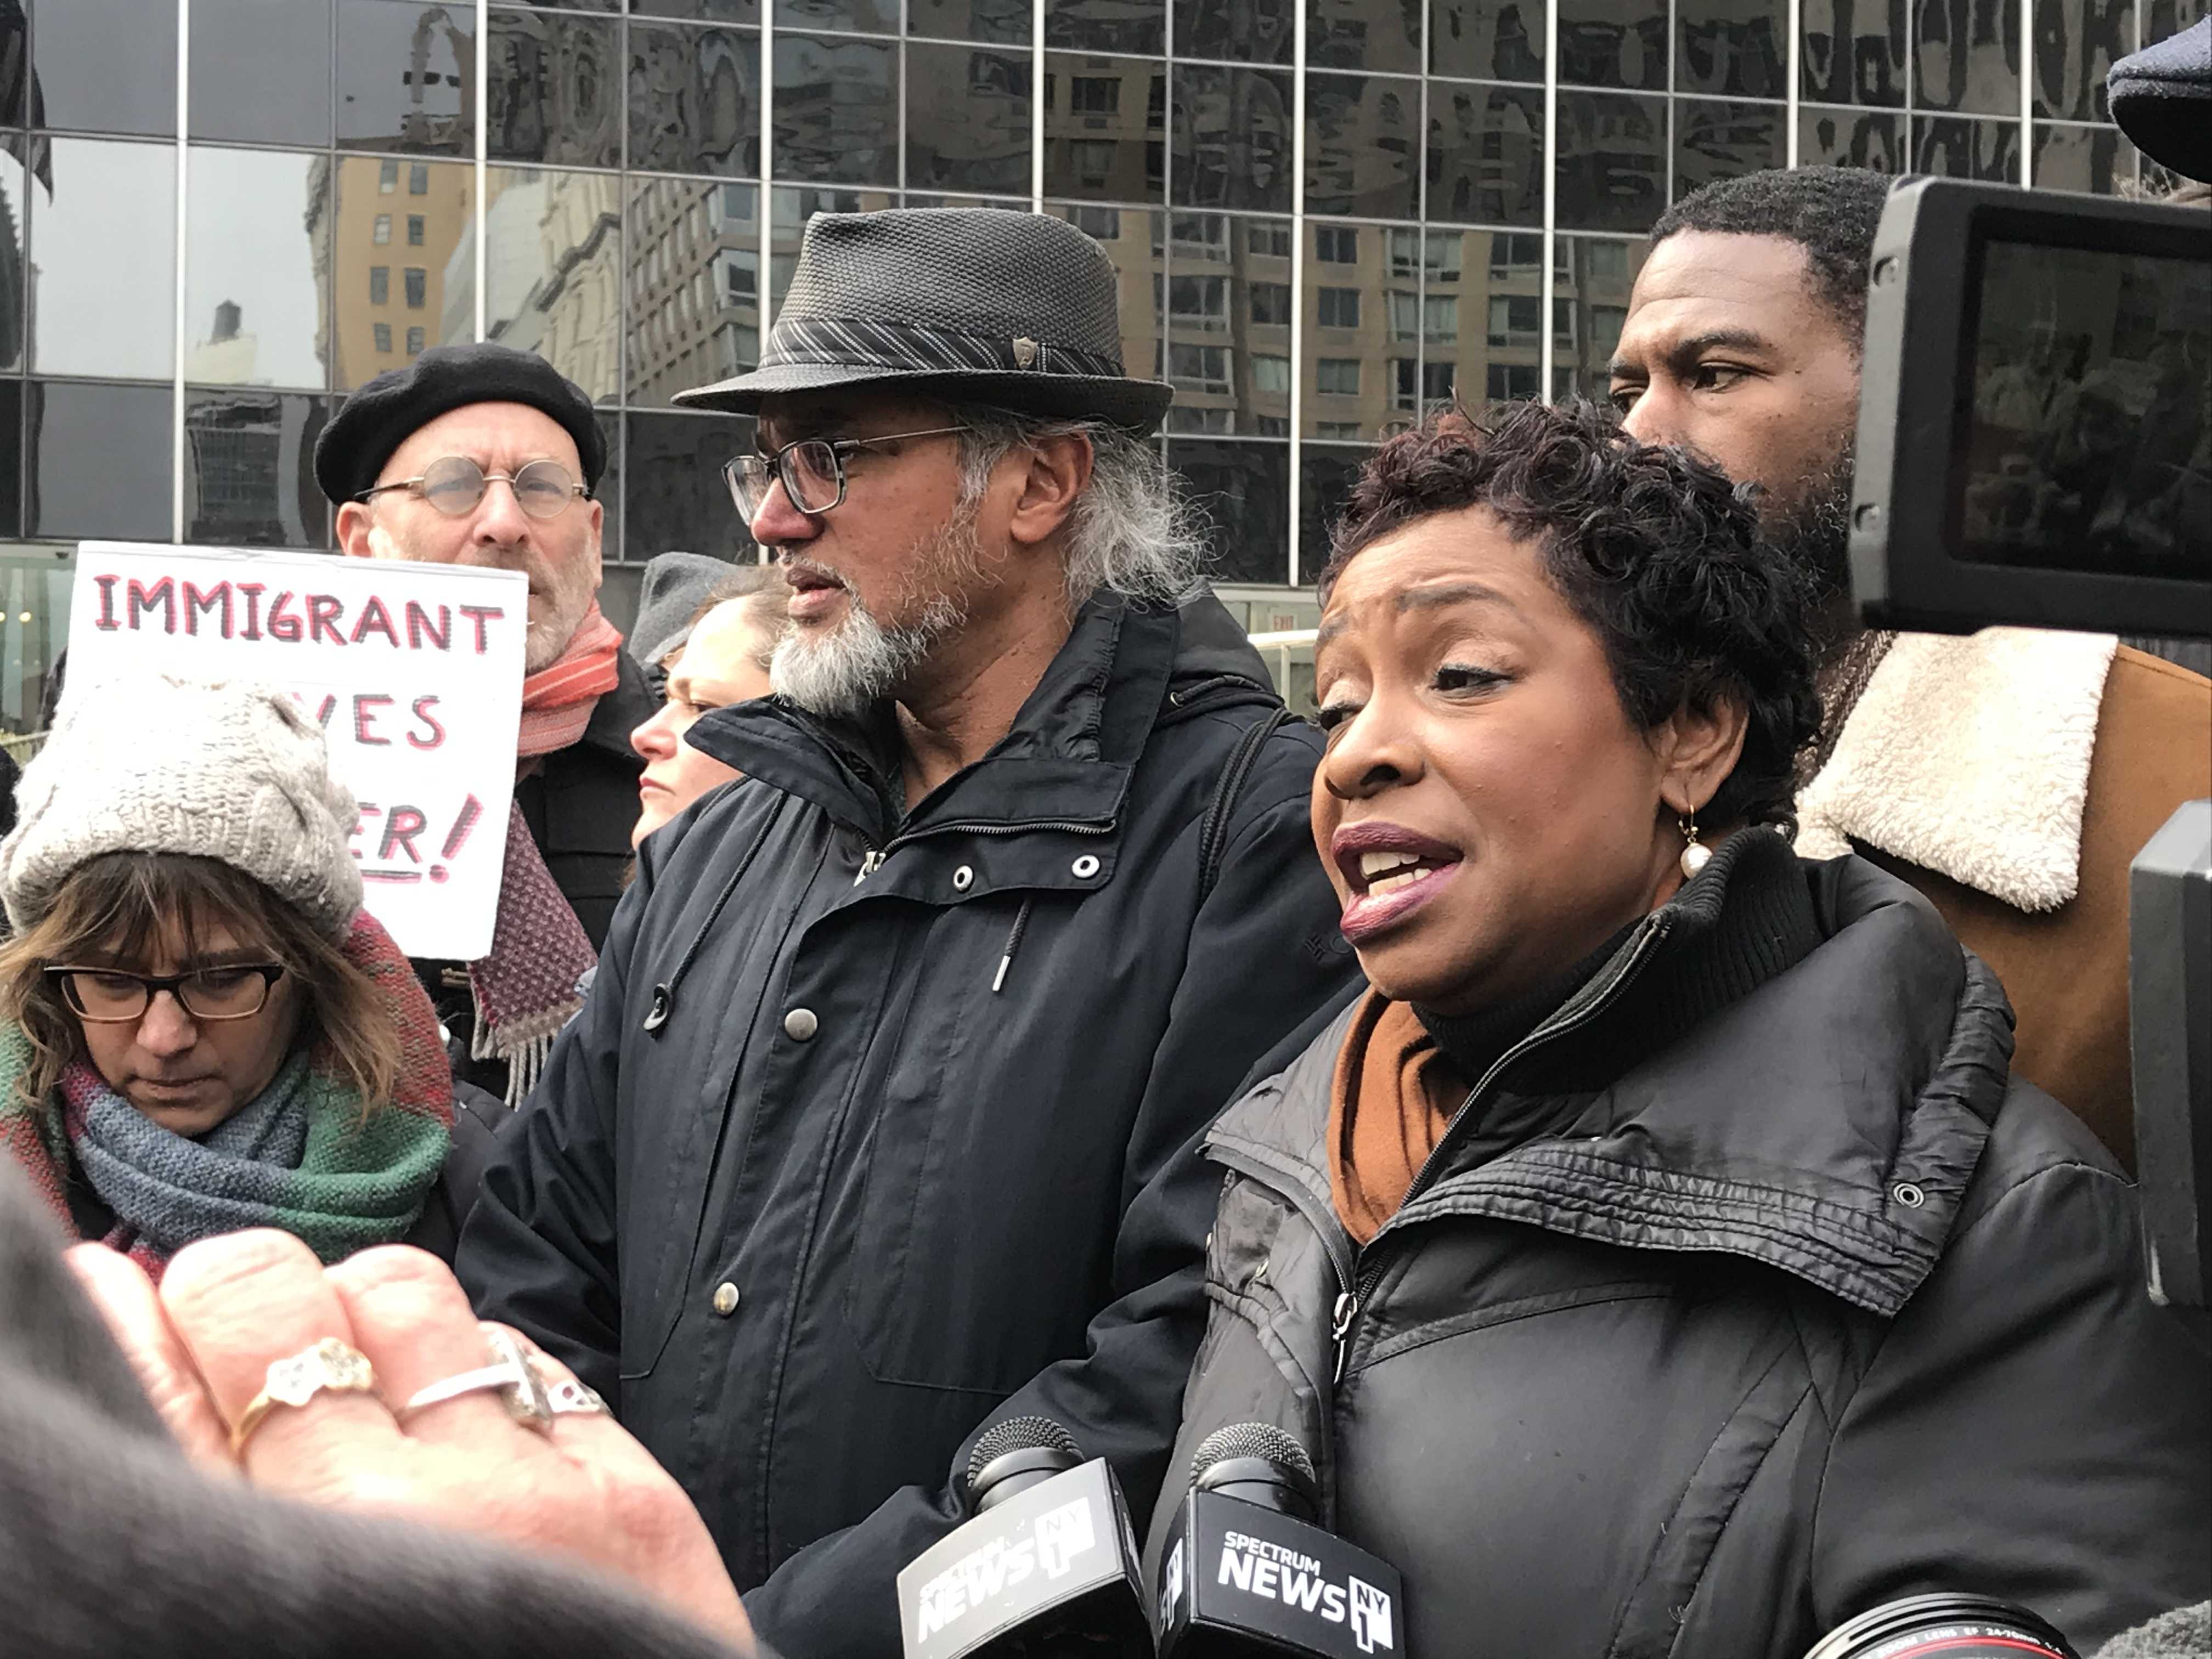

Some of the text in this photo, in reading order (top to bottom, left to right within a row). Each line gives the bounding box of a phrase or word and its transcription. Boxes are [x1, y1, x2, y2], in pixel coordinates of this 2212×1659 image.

[94, 574, 505, 655] IMMIGRANT
[918, 1537, 1035, 1644] NEWS
[1217, 1547, 1347, 1623] NEWS
[1224, 1531, 1321, 1576] SPECTRUM
[1925, 1629, 1957, 1640] LENS
